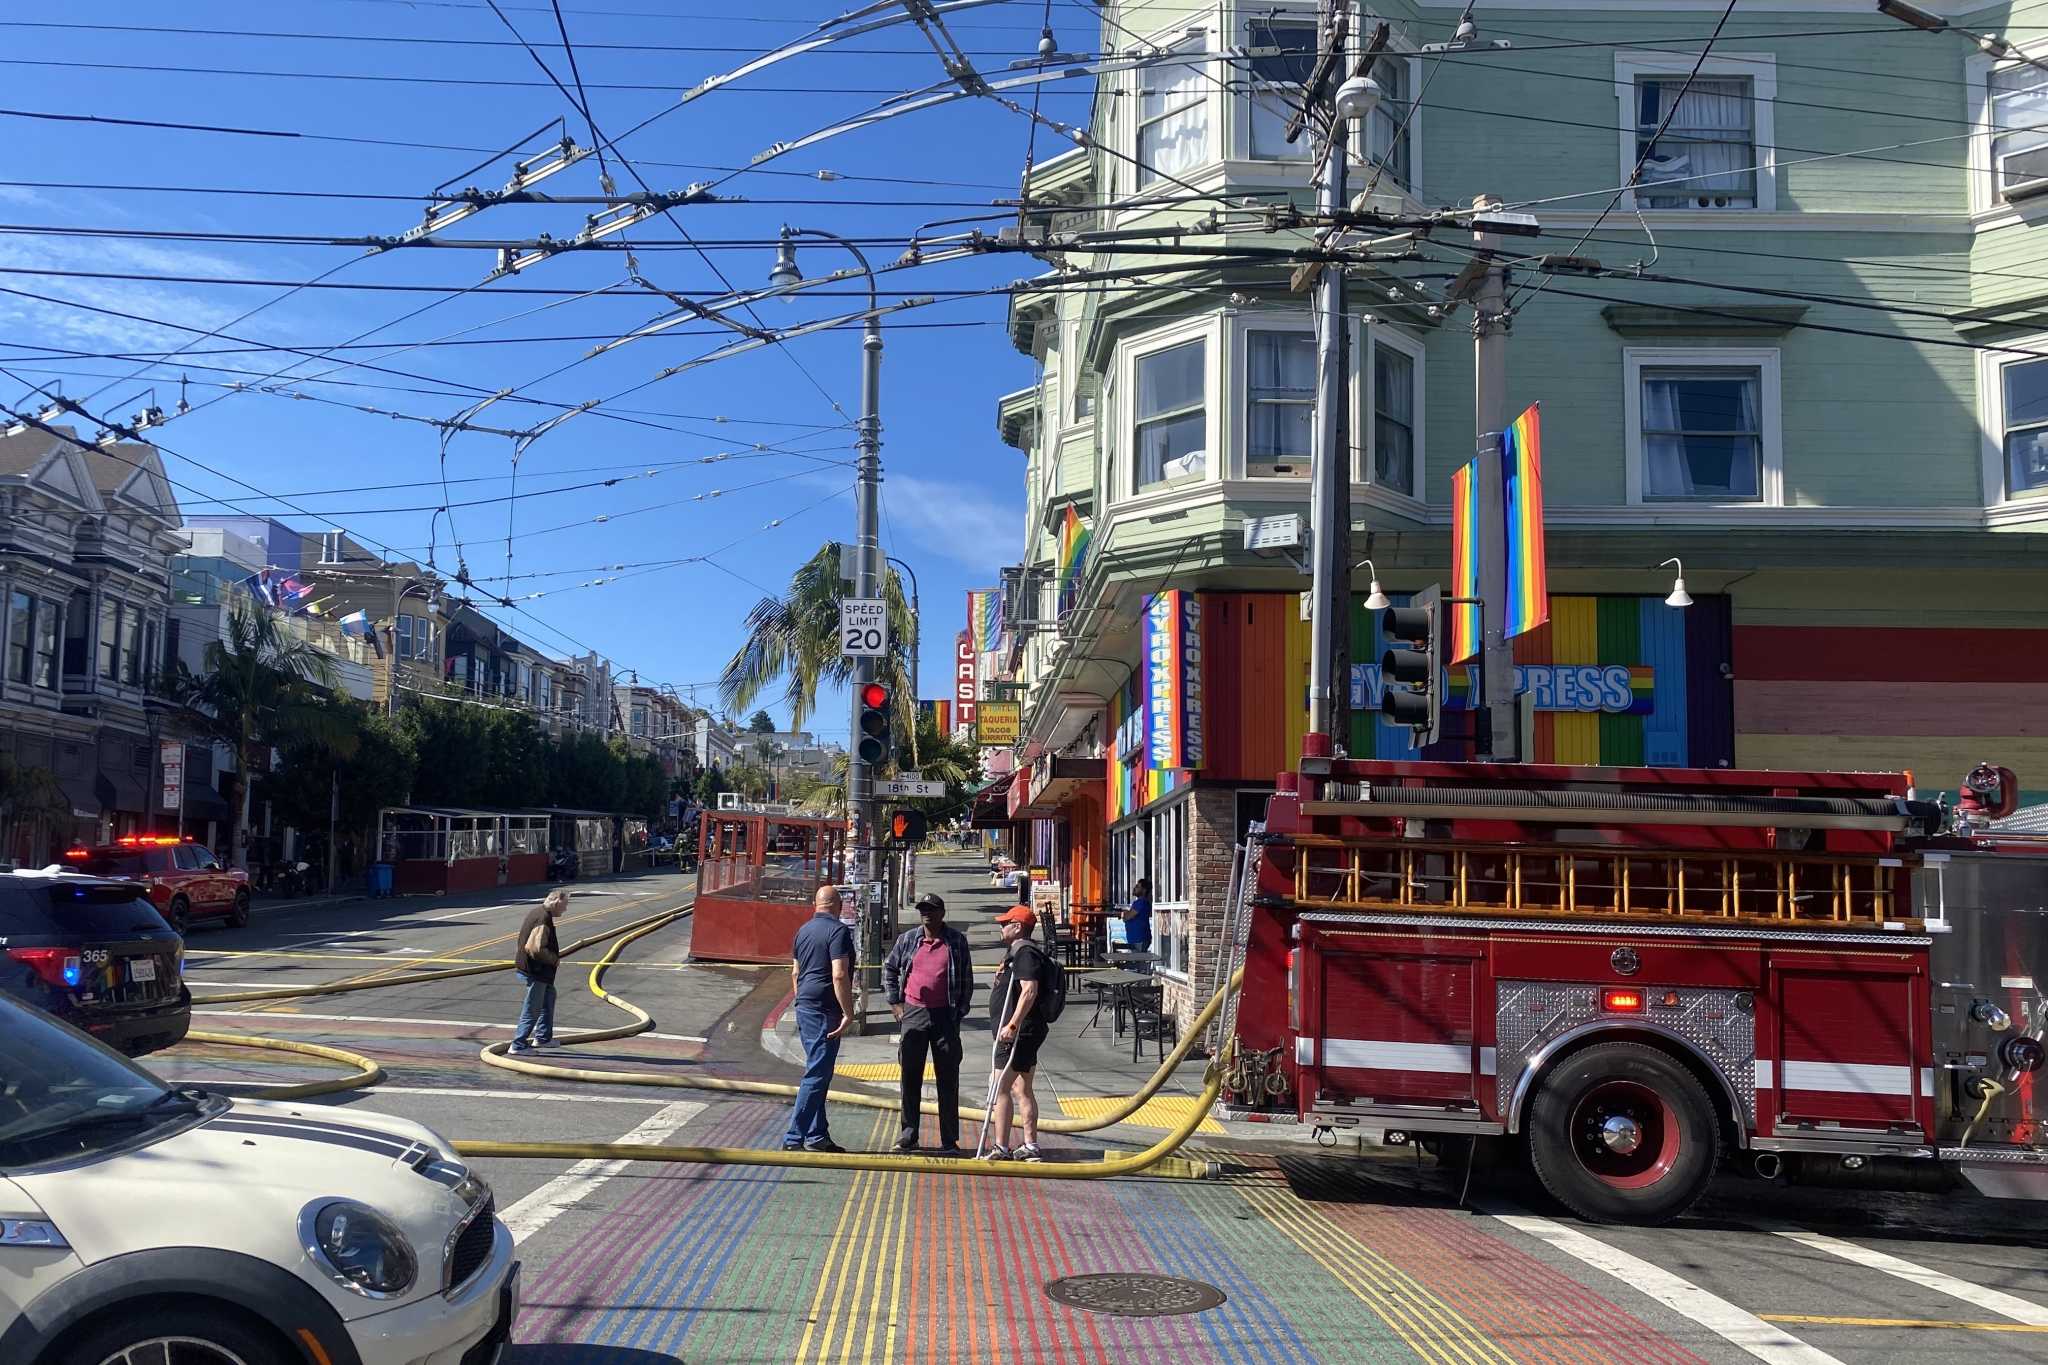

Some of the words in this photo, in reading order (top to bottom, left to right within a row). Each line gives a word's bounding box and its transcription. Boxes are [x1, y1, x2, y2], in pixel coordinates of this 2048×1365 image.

[845, 605, 884, 615] SPEED
[849, 617, 880, 626] LIMIT
[846, 629, 882, 650] 20
[980, 716, 1018, 724] TAQUERIA
[887, 784, 909, 793] 18th
[916, 784, 929, 793] St
[83, 949, 108, 962] 365
